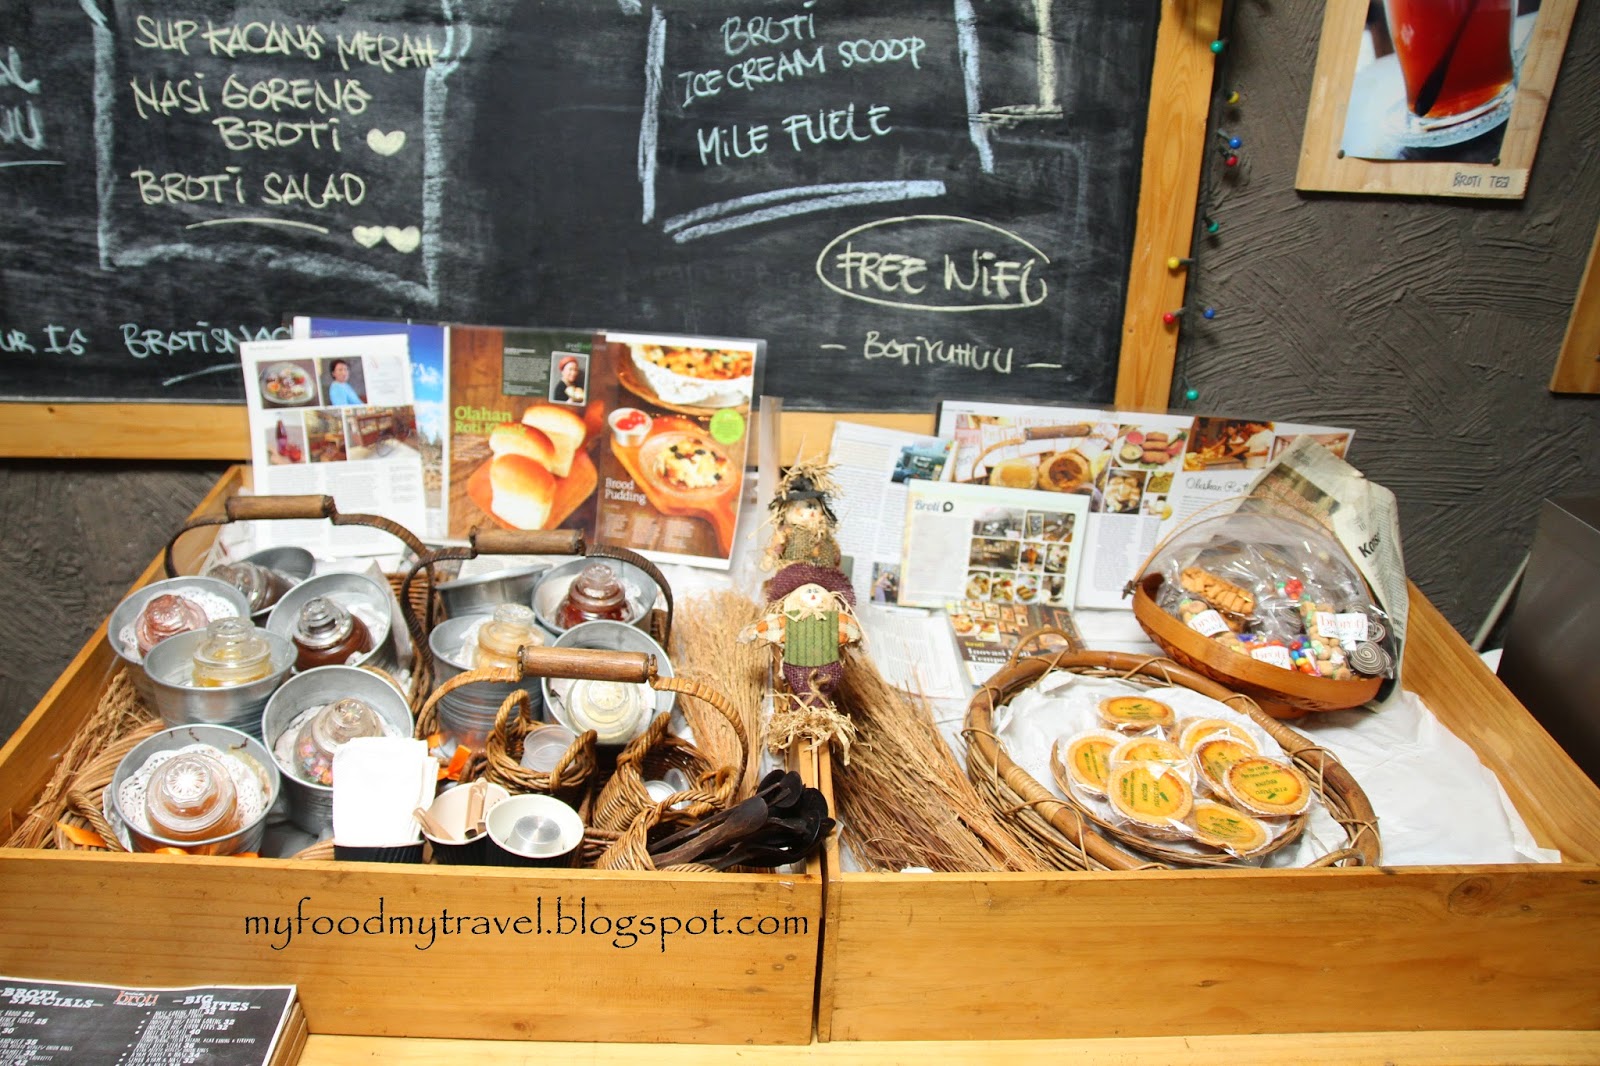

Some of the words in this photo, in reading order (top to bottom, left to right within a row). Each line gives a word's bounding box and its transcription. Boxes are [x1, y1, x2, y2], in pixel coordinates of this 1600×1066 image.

[135, 15, 198, 55] SUP
[202, 19, 326, 60] KACANG
[336, 30, 438, 72] MERAH
[838, 35, 926, 69] SCOOP
[221, 73, 373, 115] GORENG
[262, 172, 366, 209] SALAD
[836, 241, 928, 295] FREE
[454, 405, 513, 422] Olahan
[604, 488, 647, 506] Pudding
[1, 987, 59, 999] BROTI
[9, 996, 95, 1008] SPECIALS
[182, 994, 215, 1005] BIG
[200, 1000, 250, 1011] BITES
